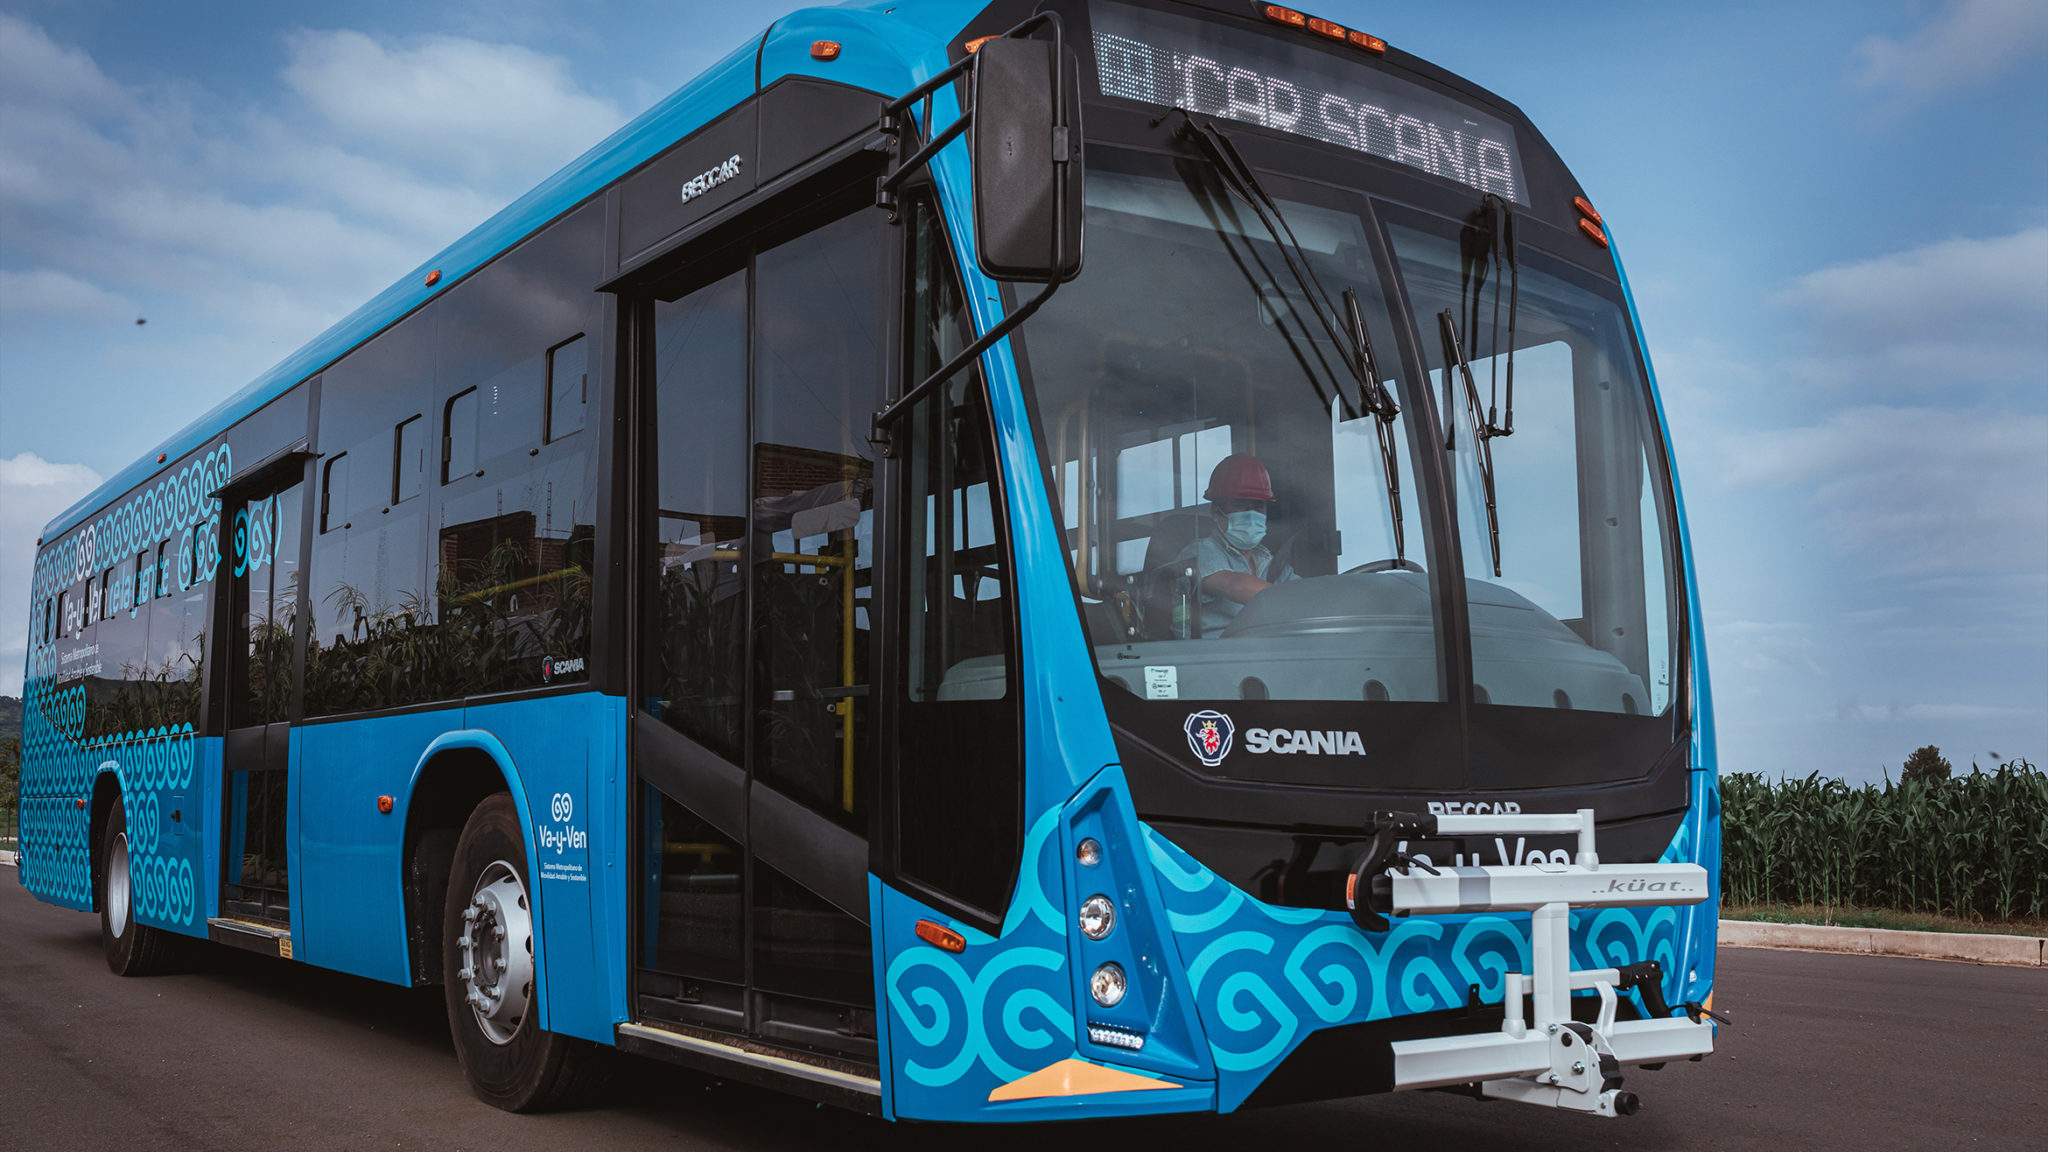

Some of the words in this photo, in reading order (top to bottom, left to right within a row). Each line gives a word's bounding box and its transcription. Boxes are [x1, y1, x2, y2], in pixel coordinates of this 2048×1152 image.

[681, 153, 741, 204] BECCAR
[553, 657, 585, 675] SCANIA
[1245, 728, 1367, 756] SCANIA
[539, 825, 587, 855] Va-y-Ven
